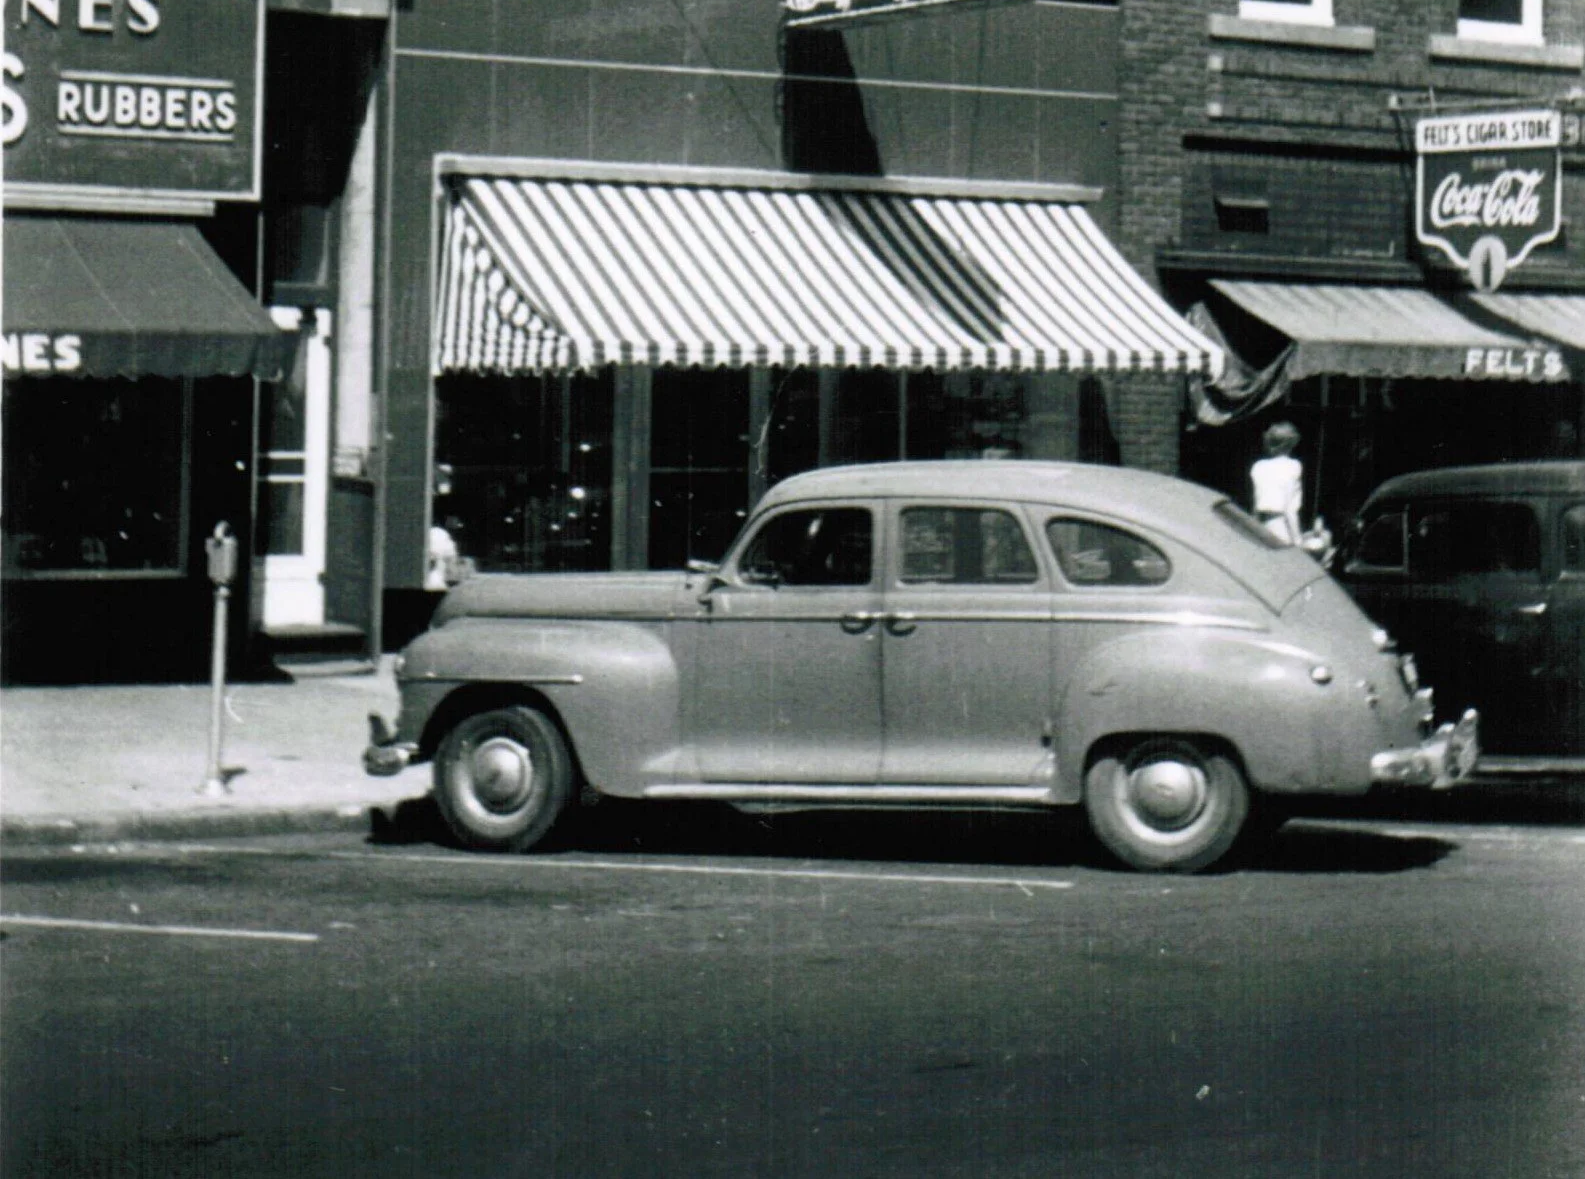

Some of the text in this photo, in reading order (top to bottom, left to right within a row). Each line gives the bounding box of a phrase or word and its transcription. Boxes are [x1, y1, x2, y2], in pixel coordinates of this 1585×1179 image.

[58, 82, 237, 130] RUBBERS
[1424, 123, 1461, 147] FELT'S
[1466, 121, 1507, 145] CIGAR
[1511, 119, 1553, 141] STORE
[1430, 167, 1545, 229] Coca-Cola
